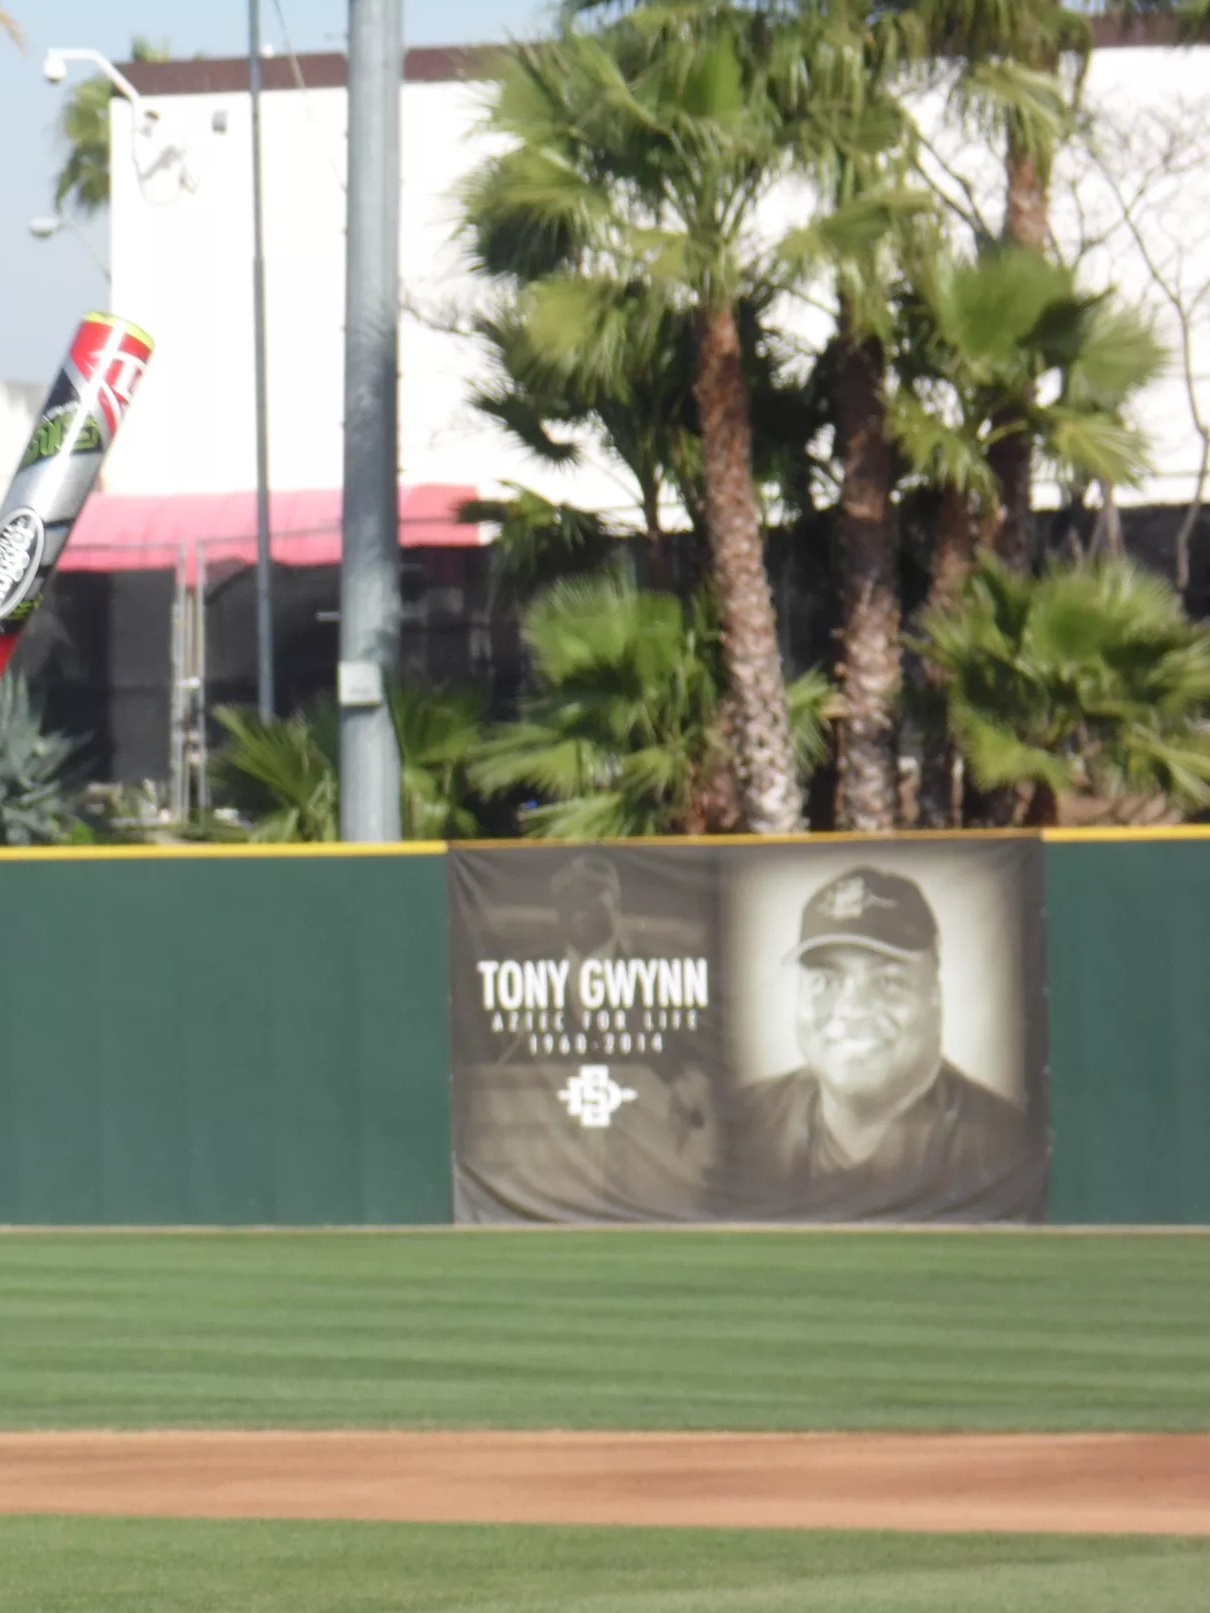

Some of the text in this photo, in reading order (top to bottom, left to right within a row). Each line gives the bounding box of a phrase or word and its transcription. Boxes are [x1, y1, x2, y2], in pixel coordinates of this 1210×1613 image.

[477, 957, 709, 1010] TONY GWYNN
[491, 1009, 698, 1032] AZTEC FOR LIFE
